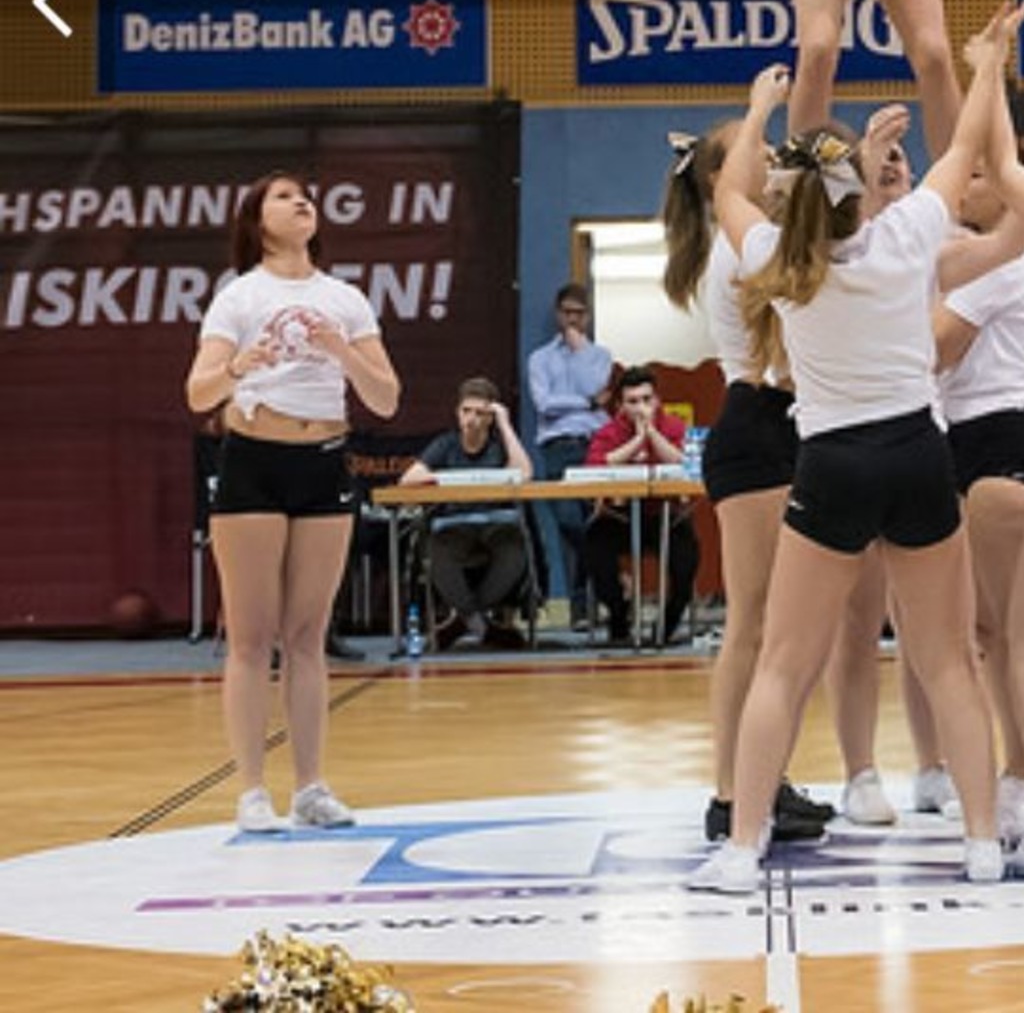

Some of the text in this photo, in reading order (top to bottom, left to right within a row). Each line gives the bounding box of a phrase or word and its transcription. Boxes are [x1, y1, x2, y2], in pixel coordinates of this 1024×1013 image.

[123, 8, 395, 52] DenizBank AG
[0, 183, 454, 232] HSPANNG IN
